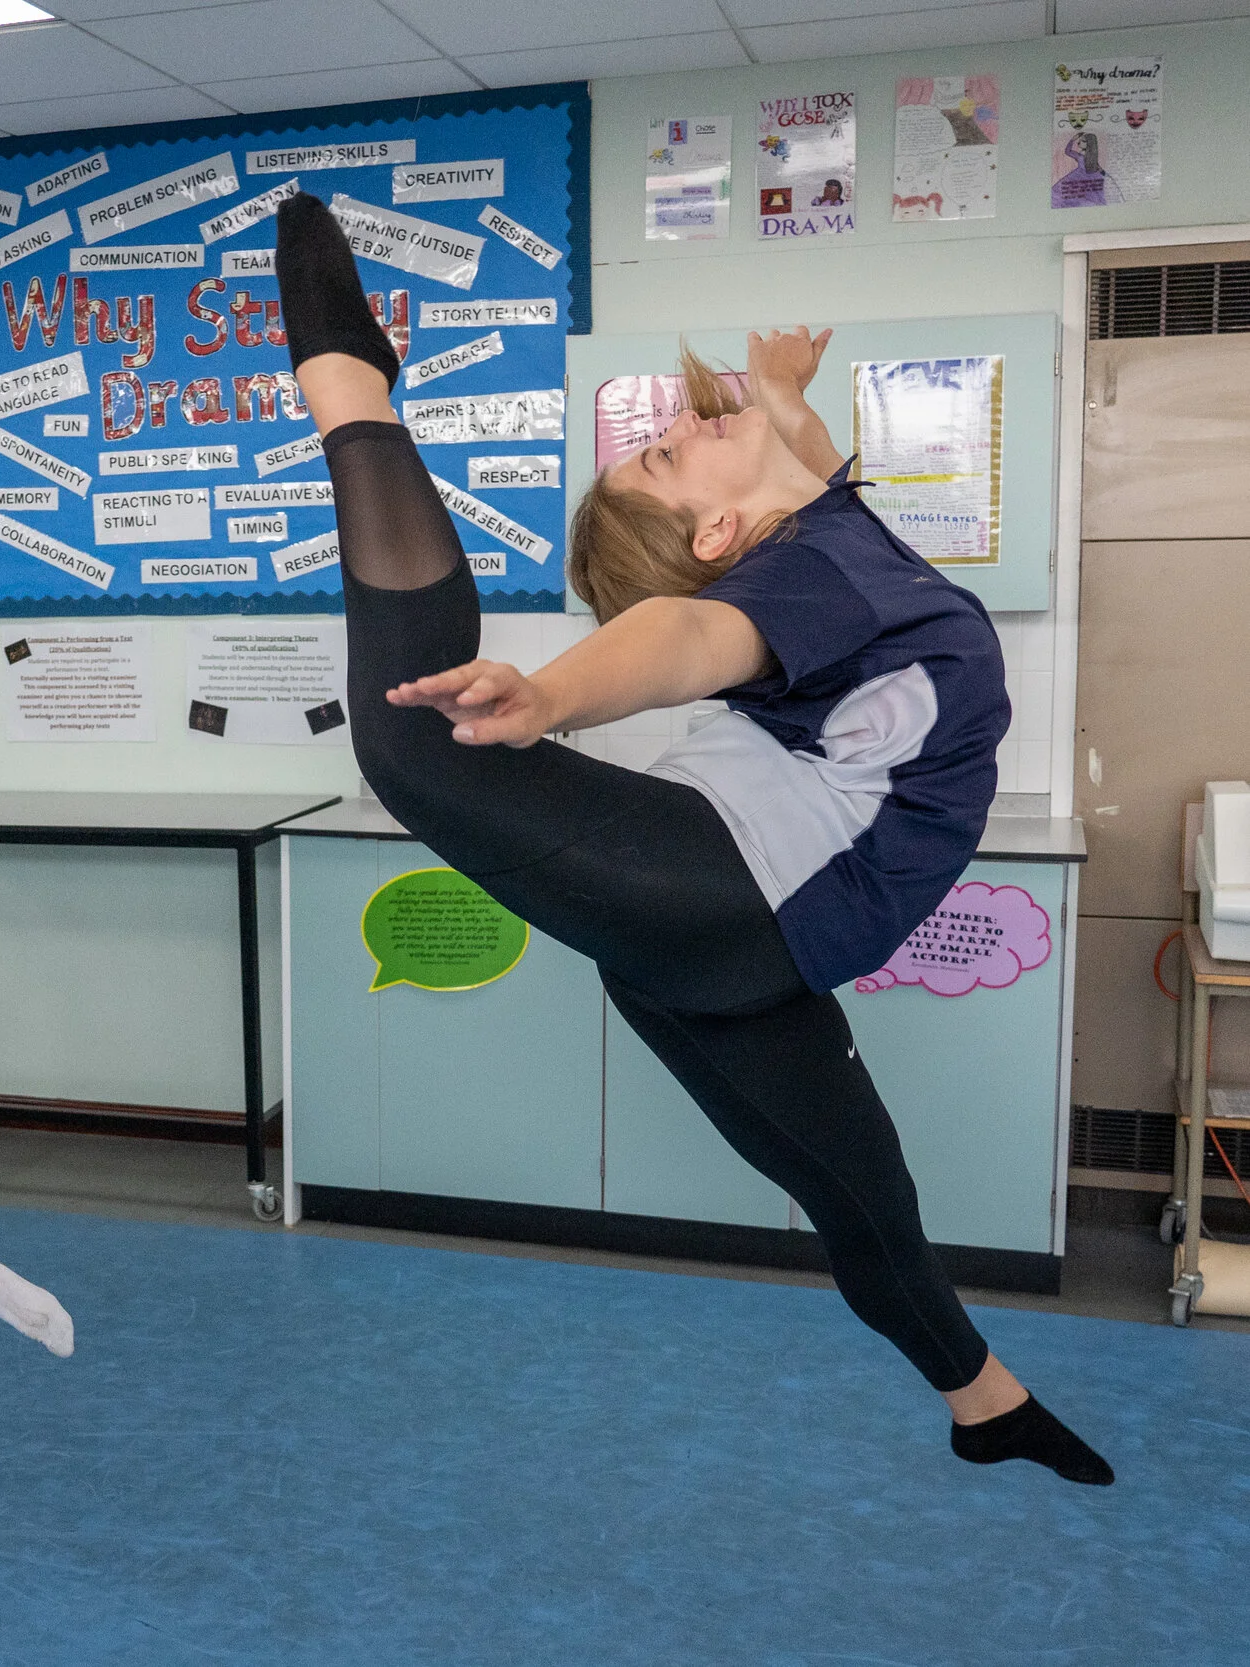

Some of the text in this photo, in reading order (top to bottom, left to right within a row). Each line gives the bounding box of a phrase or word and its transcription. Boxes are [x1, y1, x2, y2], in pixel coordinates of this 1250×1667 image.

[1109, 64, 1161, 79] drama?
[812, 92, 854, 110] TOOK
[777, 111, 826, 127] GCSE
[256, 143, 389, 169] LISTENING SKILLS
[36, 157, 103, 197] ADAPTING
[405, 168, 495, 188] CREATIVITY
[89, 169, 217, 227] PROBLEM SOLVING
[2, 230, 53, 262] ASKING
[410, 233, 477, 261] OUTSIDE
[488, 215, 554, 261] RESPECT
[78, 250, 198, 267] COMMUNICATION
[363, 241, 393, 259] BOX
[2, 274, 411, 370] Why Stuy
[431, 308, 481, 323] STORY
[419, 340, 492, 378] COURAGE
[12, 374, 32, 391] TO
[33, 364, 70, 385] READ
[101, 370, 309, 442] Dram
[54, 420, 81, 433] FUN
[0, 436, 86, 486] SPONTANEITY
[110, 451, 233, 469] PUBLIC SPEKING
[266, 438, 324, 466] SELF-AW
[479, 469, 550, 484] RESPECT
[103, 492, 207, 511] REACTING TO A
[225, 487, 335, 502] EVALUATIVE SK
[104, 515, 158, 529] STIMULI
[898, 513, 978, 523] EXAGGERATED
[234, 521, 284, 535] TIMING
[0, 524, 107, 582] COLLABORATION
[285, 545, 341, 574] RESEAR
[150, 563, 248, 577] NEGOGIATION
[66, 636, 99, 644] Performing
[212, 635, 247, 643] Component
[255, 635, 293, 643] Interpreting
[932, 910, 998, 925] EMBER:
[912, 930, 1001, 947] ALL PARTS,
[947, 923, 979, 933] ARE
[984, 927, 1004, 936] NO
[905, 940, 992, 957] NLY SMALL
